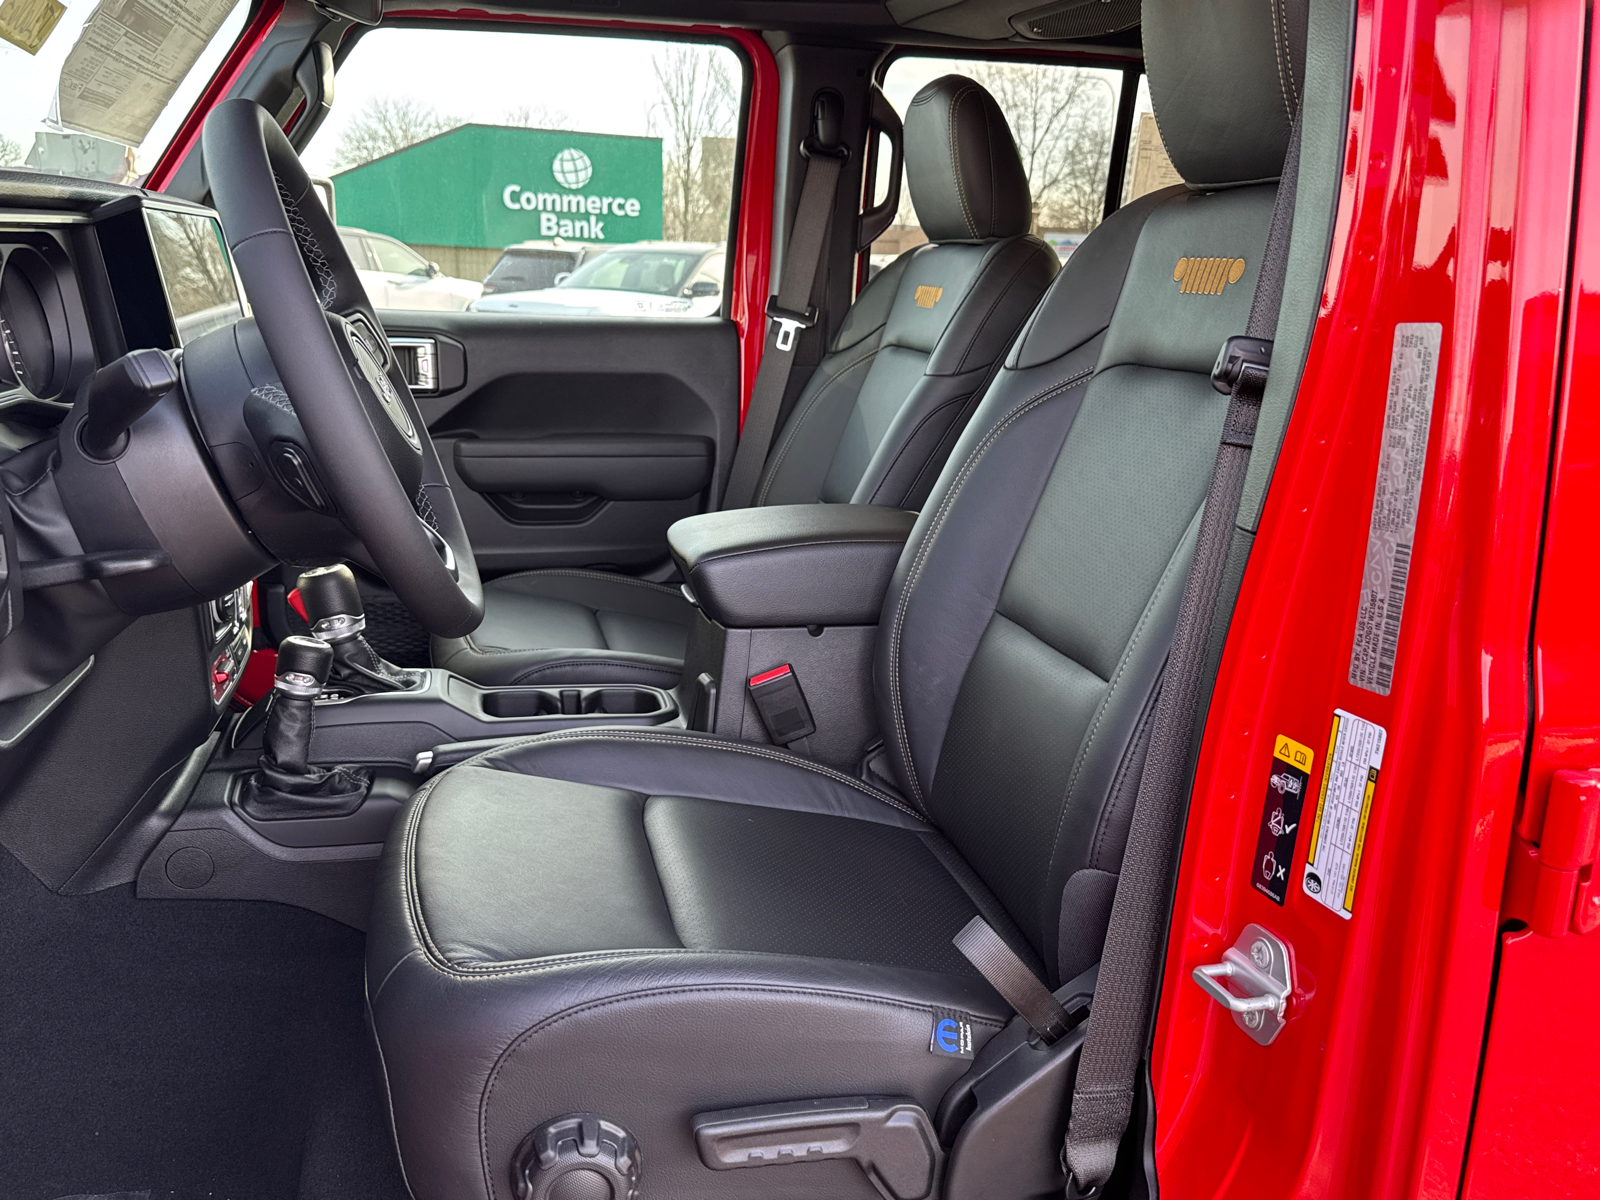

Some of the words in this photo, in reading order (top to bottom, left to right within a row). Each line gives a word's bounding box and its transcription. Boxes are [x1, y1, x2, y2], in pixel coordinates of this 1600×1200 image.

[502, 184, 641, 217] Commerce
[540, 212, 605, 239] Bank
[1358, 620, 1365, 631] US
[1366, 654, 1376, 685] VEHICLE
[1371, 632, 1379, 654] MADE
[1376, 594, 1385, 618] U.S.A.
